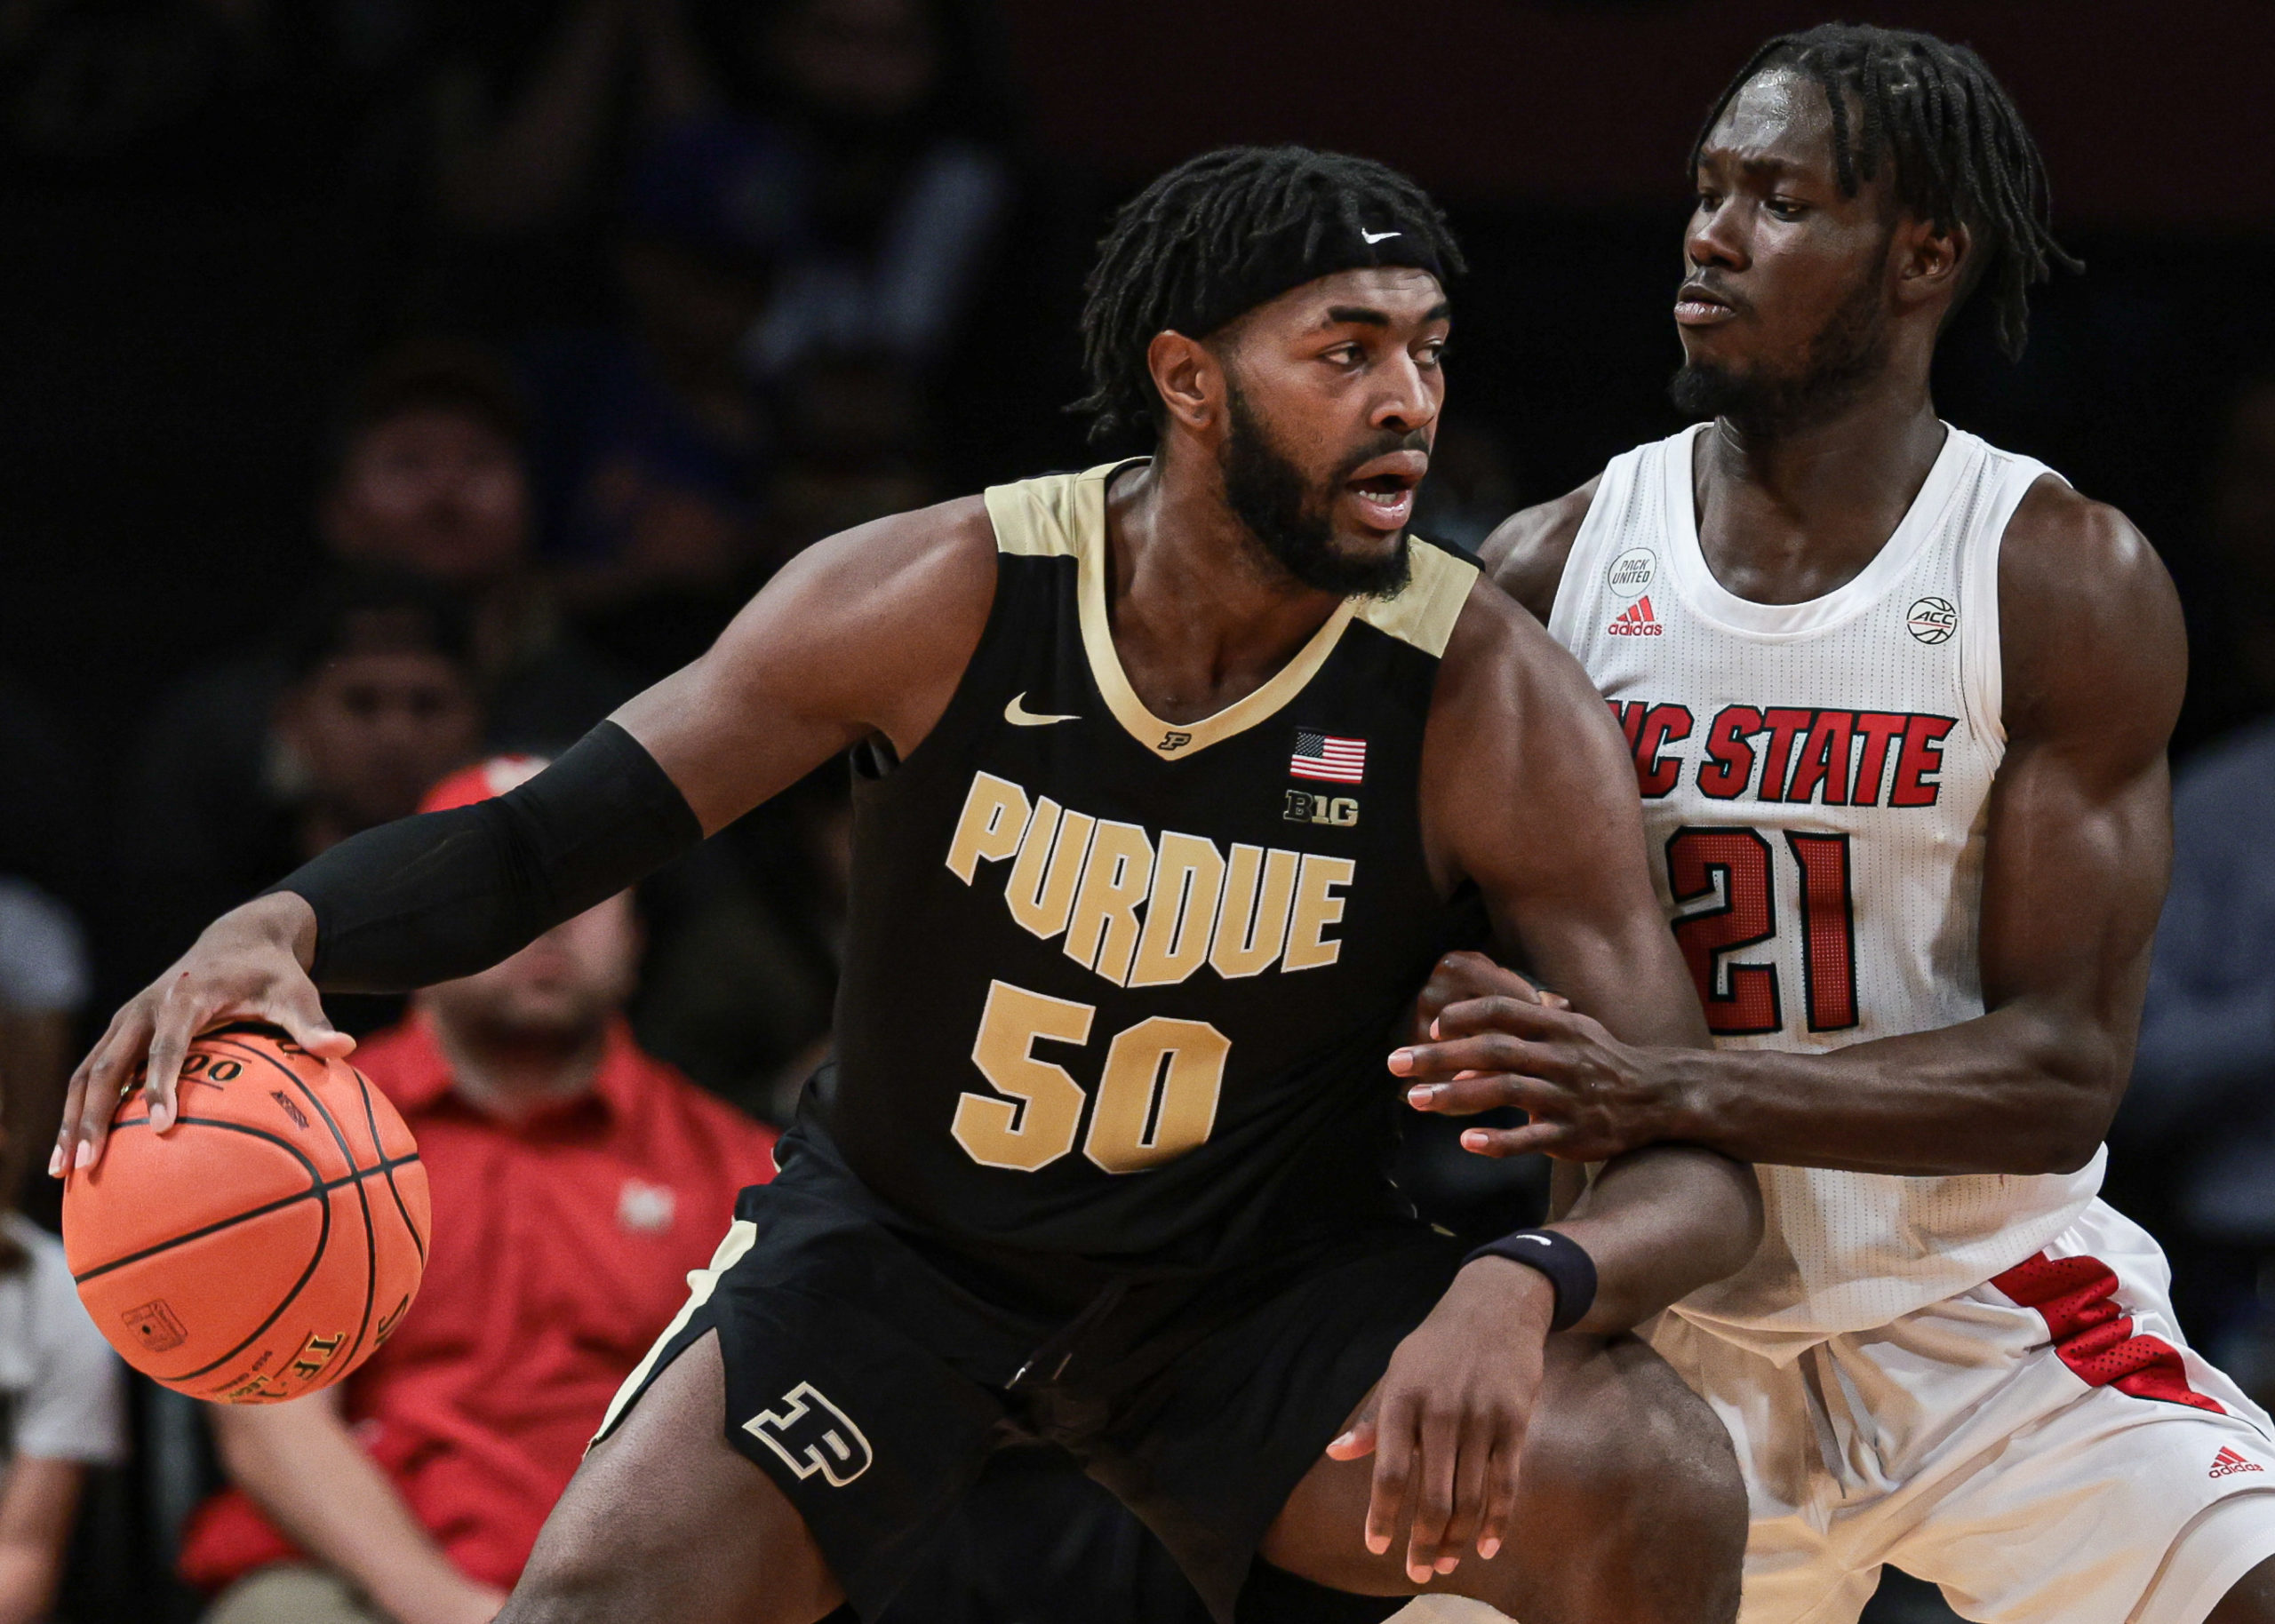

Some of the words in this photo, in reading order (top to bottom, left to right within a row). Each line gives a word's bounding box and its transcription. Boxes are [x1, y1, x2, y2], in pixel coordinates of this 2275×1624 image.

[1620, 559, 1650, 571] PACK
[1612, 570, 1651, 585] UNITED
[1912, 610, 1957, 625] ACC
[1608, 620, 1663, 636] adidas
[1157, 731, 1193, 751] P
[1695, 704, 1959, 808] STATE
[945, 770, 1356, 988] PURDUE
[1664, 825, 1860, 1034] 21
[951, 978, 1232, 1174] 50
[741, 1381, 873, 1487] P
[2208, 1462, 2264, 1479] adidas
